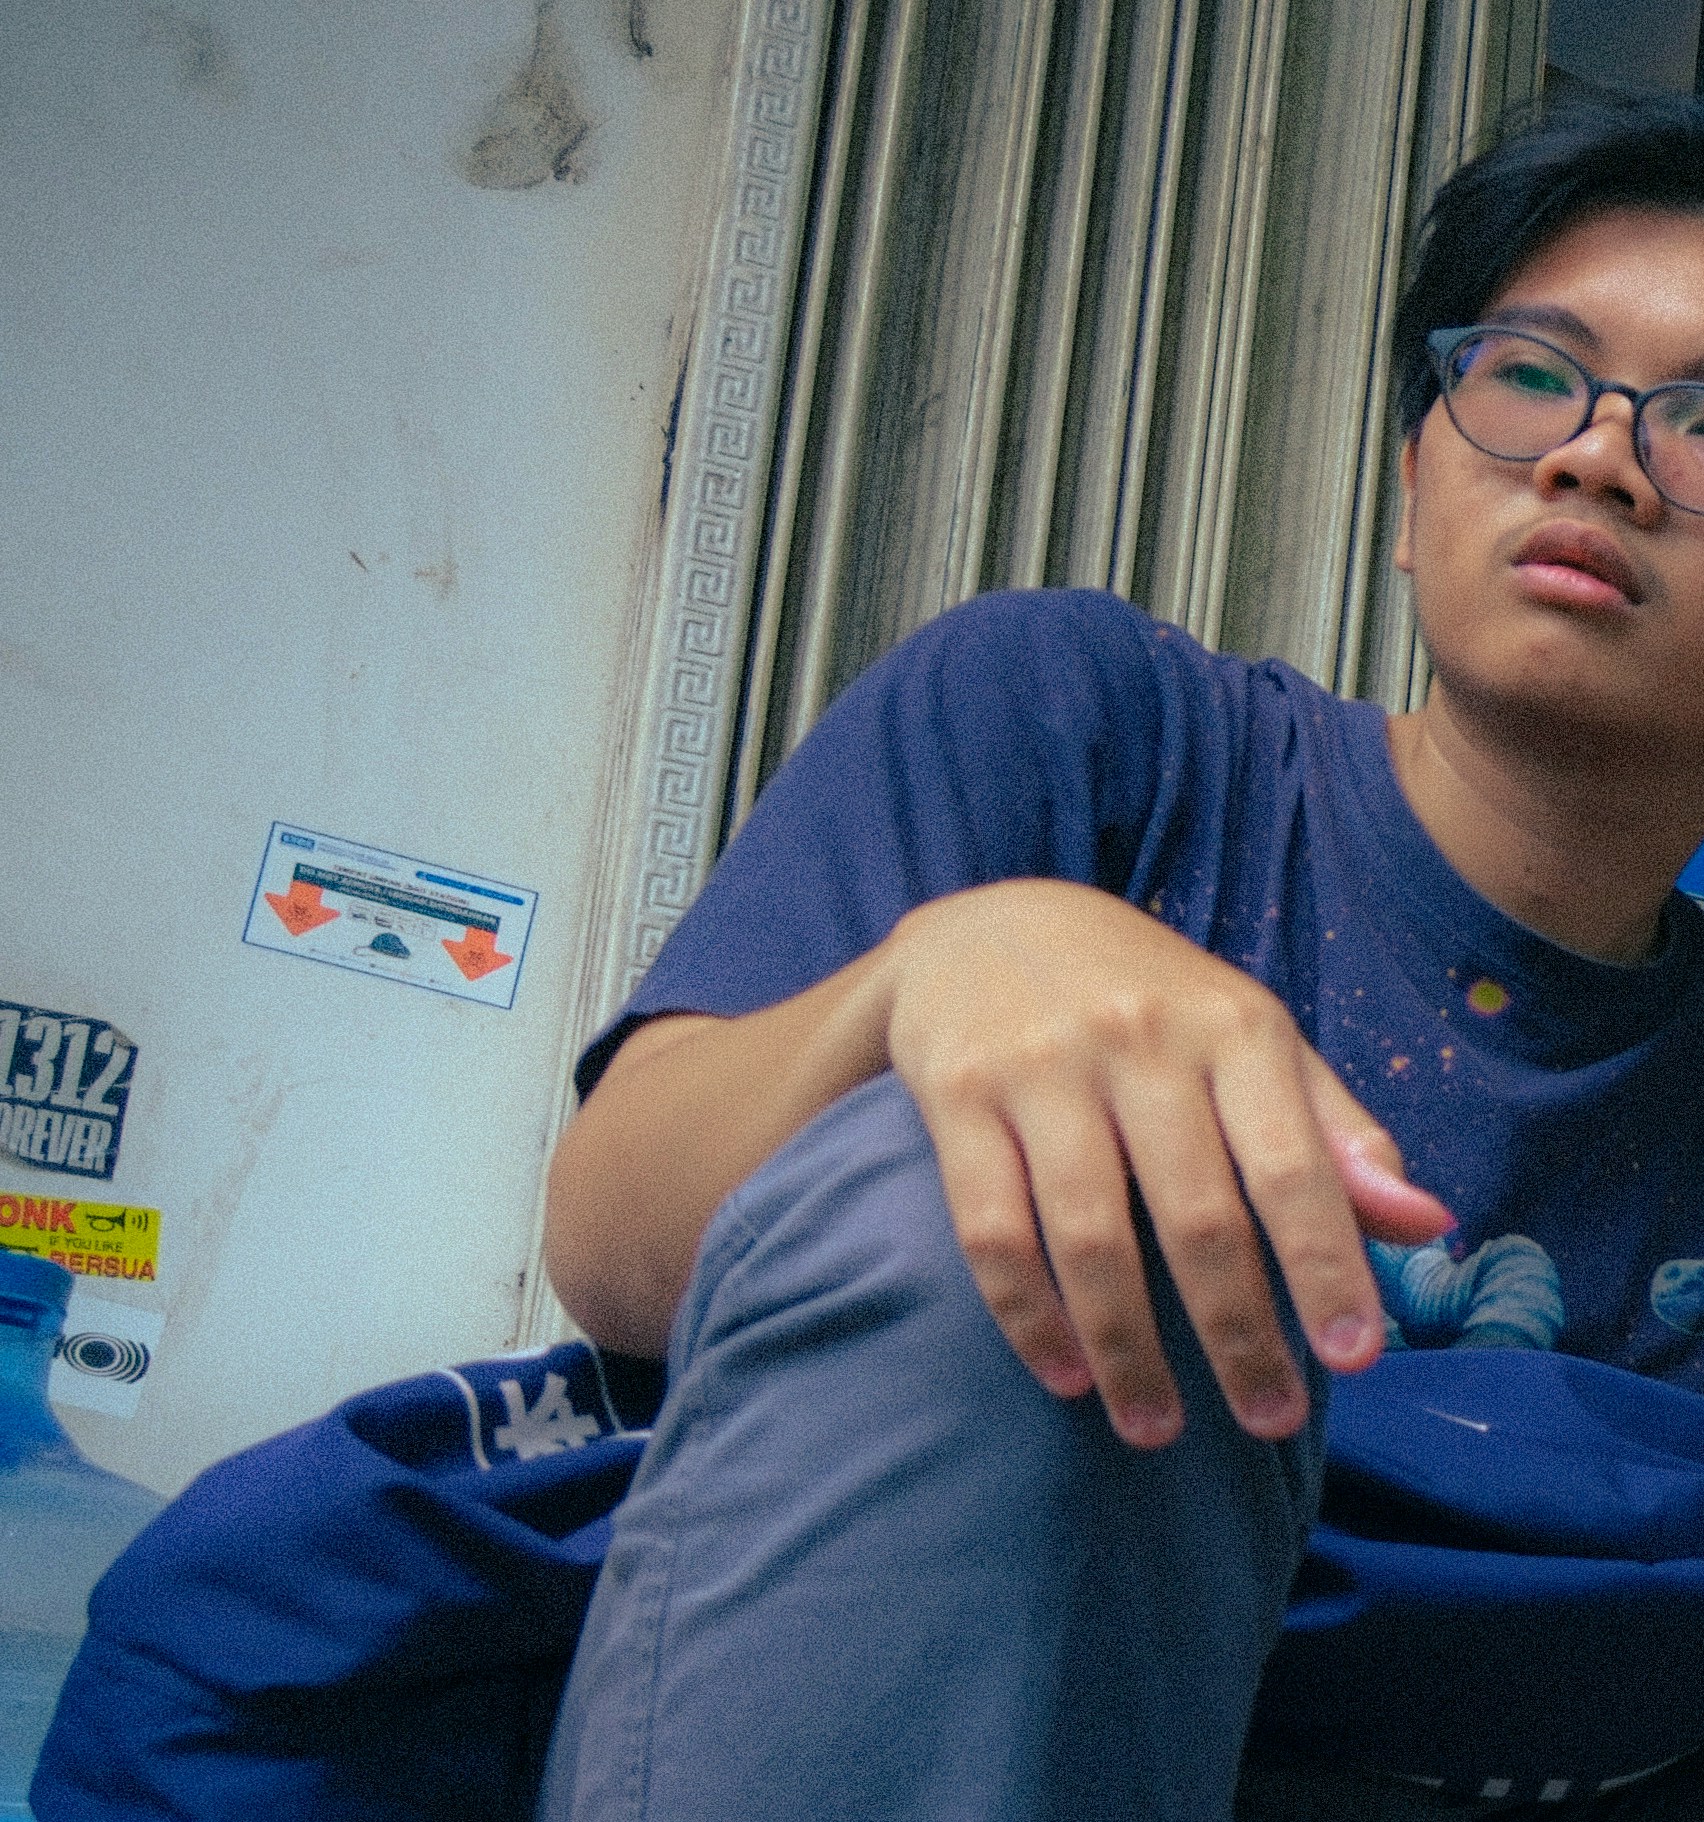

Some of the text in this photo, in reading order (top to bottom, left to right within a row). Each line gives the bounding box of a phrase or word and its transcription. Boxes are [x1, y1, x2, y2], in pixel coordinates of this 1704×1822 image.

[0, 1008, 130, 1117] 1312
[49, 1236, 122, 1253] IF YOU LIKE
